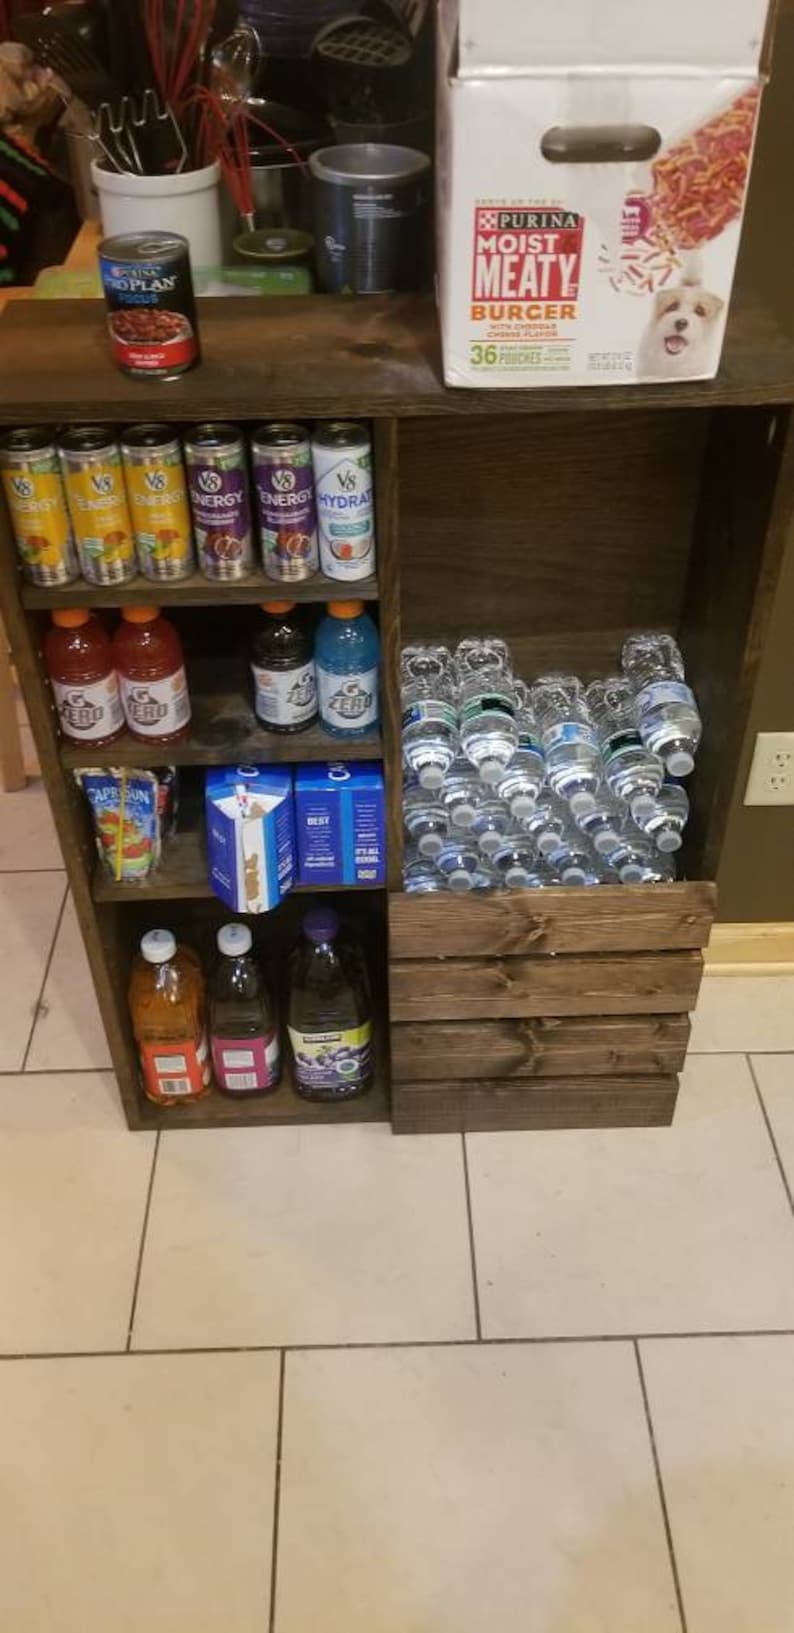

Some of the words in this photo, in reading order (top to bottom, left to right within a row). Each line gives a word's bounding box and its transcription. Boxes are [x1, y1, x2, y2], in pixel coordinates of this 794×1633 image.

[501, 213, 577, 228] PURINA
[477, 234, 559, 254] MOIST
[130, 275, 177, 291] PLAN
[475, 254, 577, 298] MEATY
[470, 304, 577, 321] BURGER
[470, 345, 497, 365] 36
[11, 476, 33, 496] V8
[91, 474, 113, 494] V8
[145, 471, 166, 490] V8
[200, 472, 221, 491] V8
[272, 471, 294, 490] V8
[337, 470, 356, 491] V8
